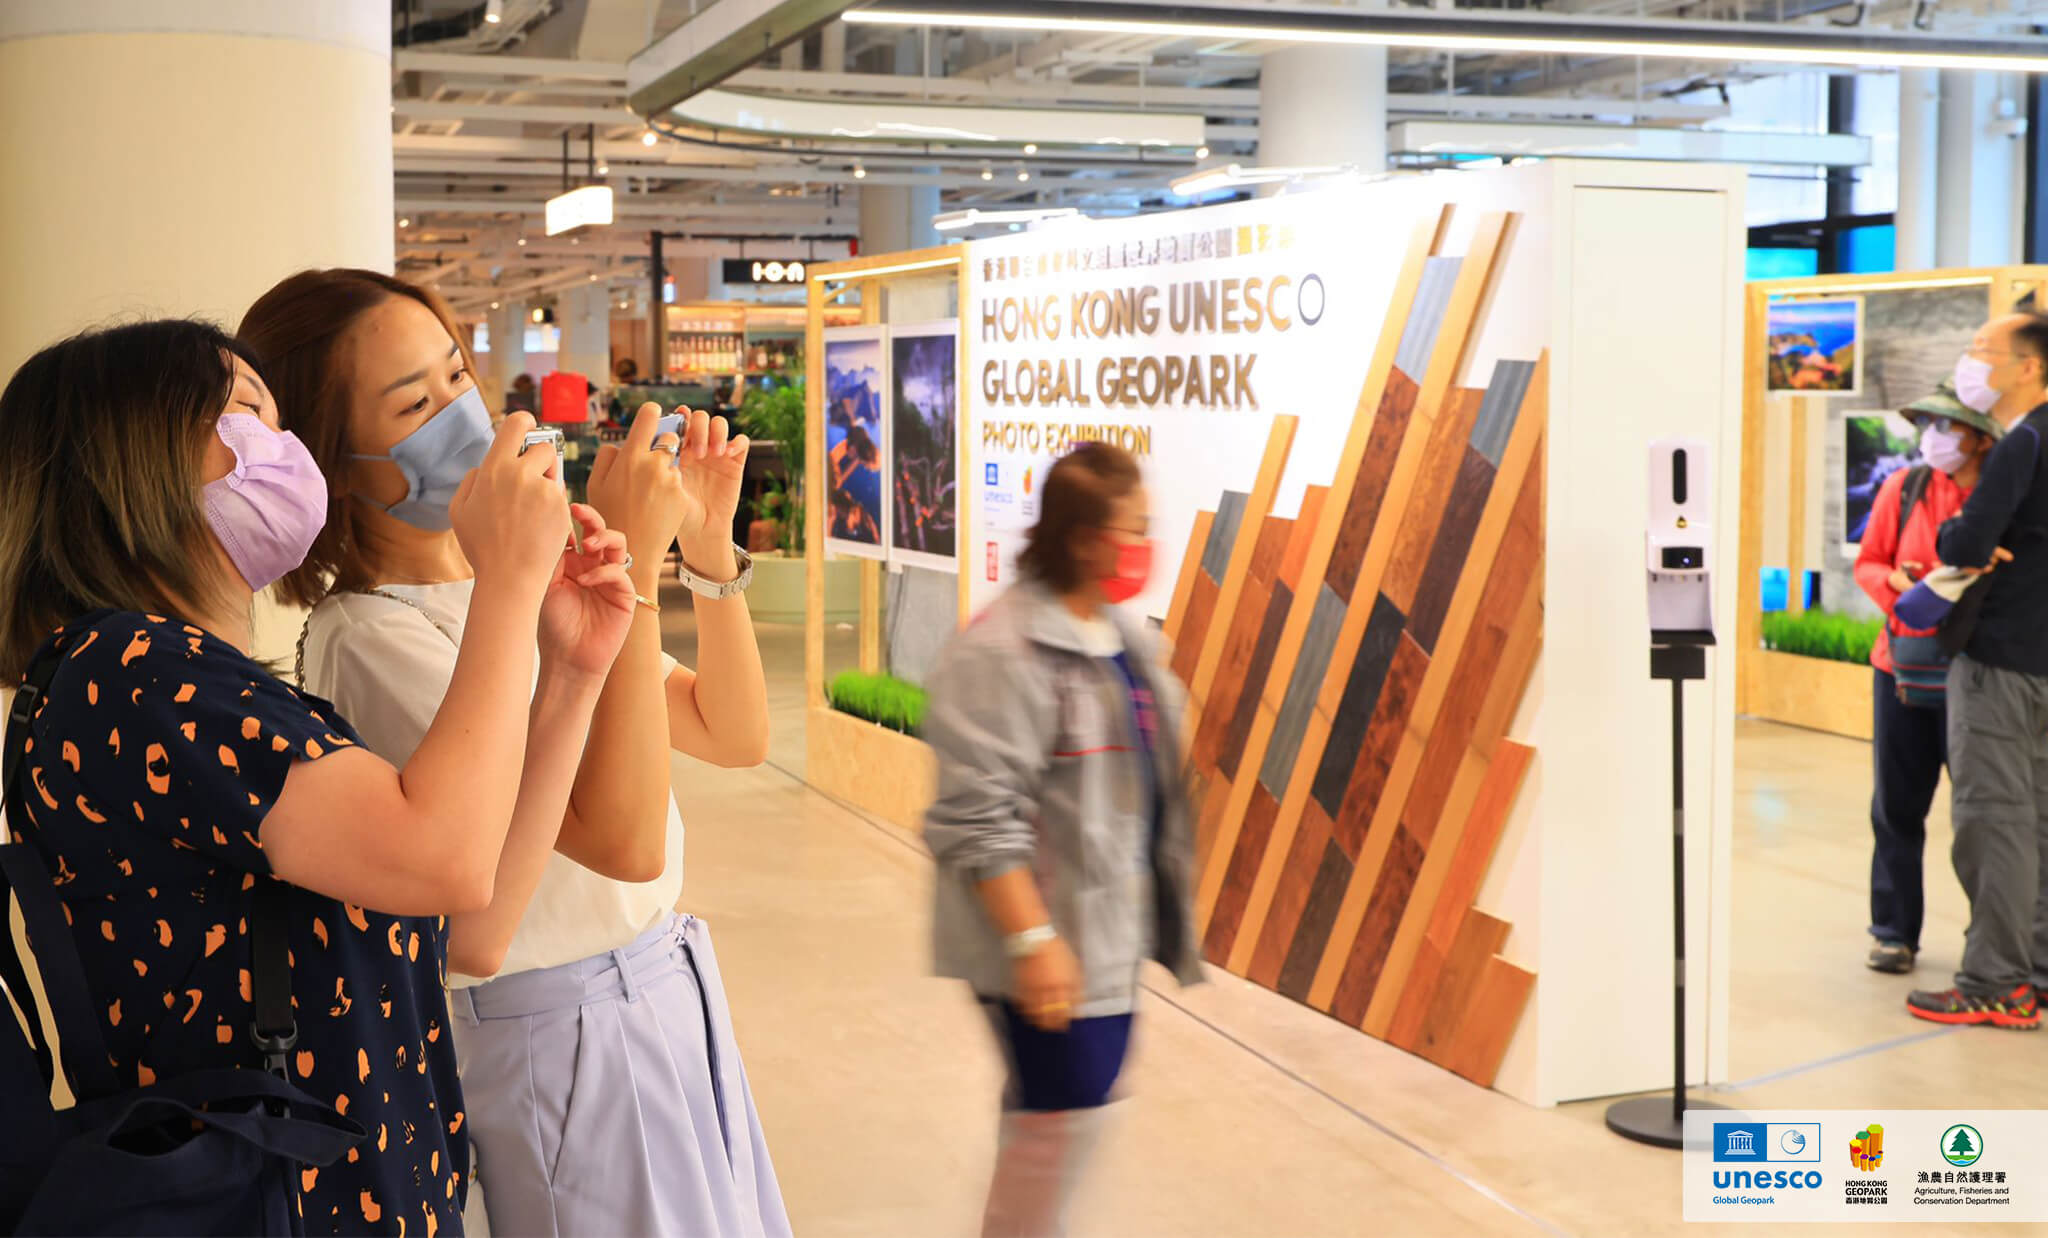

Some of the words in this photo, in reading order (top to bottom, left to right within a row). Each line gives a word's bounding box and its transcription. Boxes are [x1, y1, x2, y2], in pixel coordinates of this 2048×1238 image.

[982, 295, 1062, 342] HONG
[1071, 286, 1161, 340] KONG
[1168, 272, 1325, 336] UNESCO
[982, 358, 1090, 408] GLOBAL
[1096, 353, 1258, 410] GEOPARK
[983, 421, 1040, 454] PHOTO
